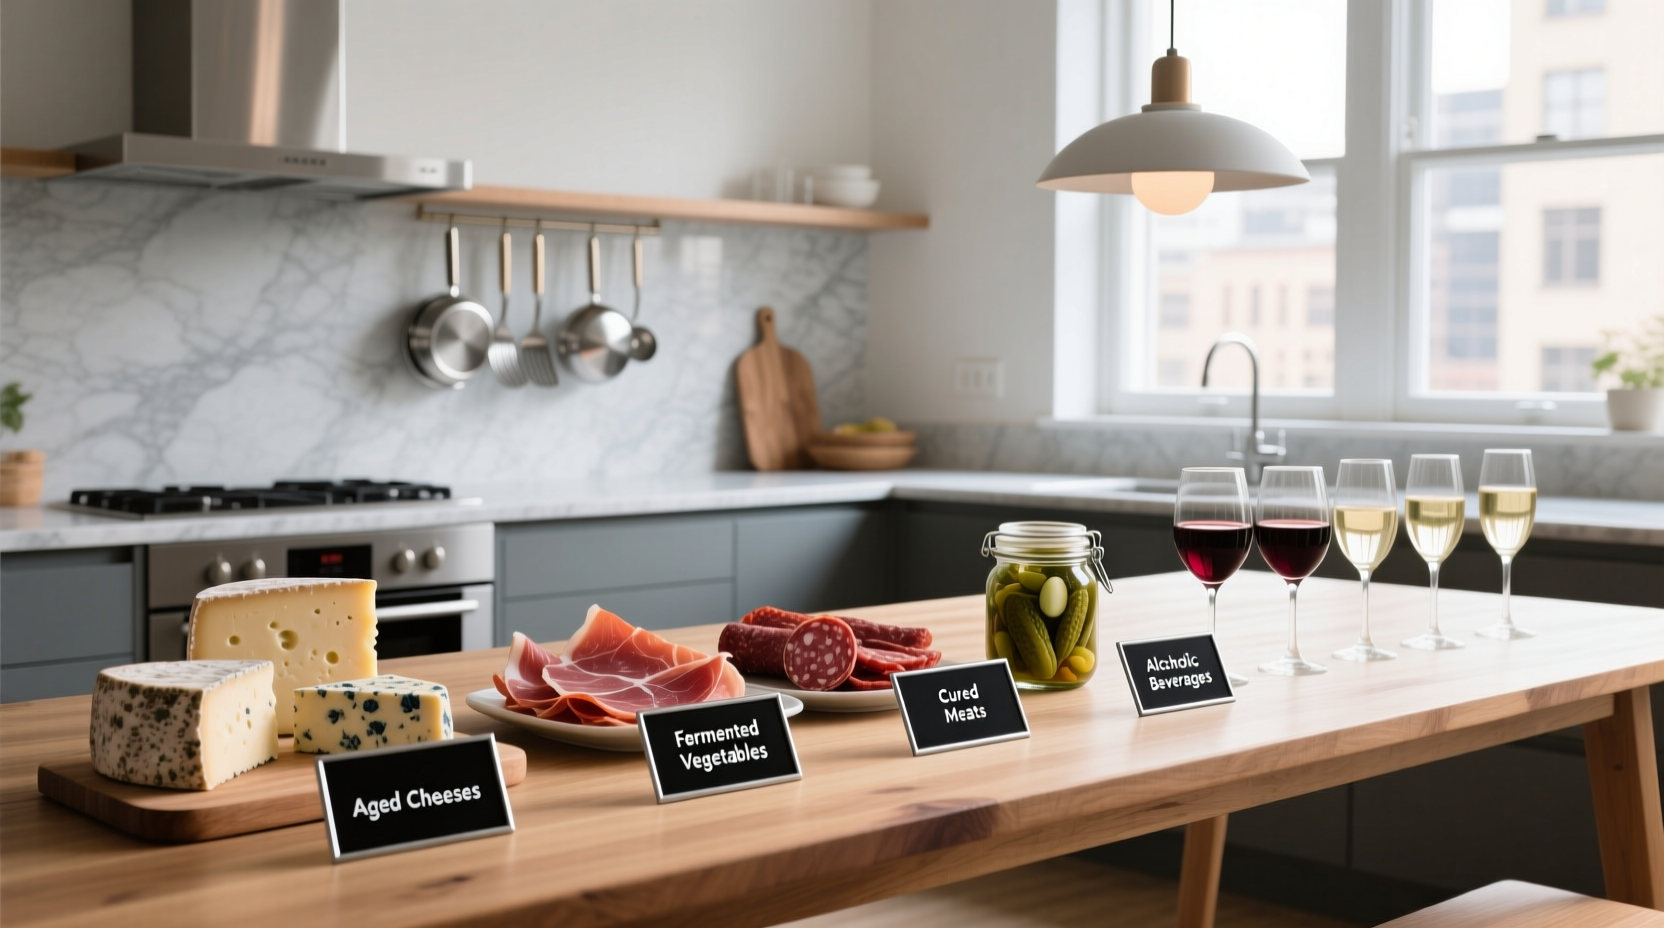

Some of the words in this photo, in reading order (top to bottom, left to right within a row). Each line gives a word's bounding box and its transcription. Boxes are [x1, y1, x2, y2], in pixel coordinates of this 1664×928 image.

[938, 683, 980, 704] Cured
[1148, 671, 1213, 691] Beverages
[944, 706, 987, 724] Meats
[674, 719, 760, 748] Fermented
[679, 743, 769, 773] Vegetables
[352, 790, 402, 822] Aged
[406, 785, 482, 809] Cheeses
